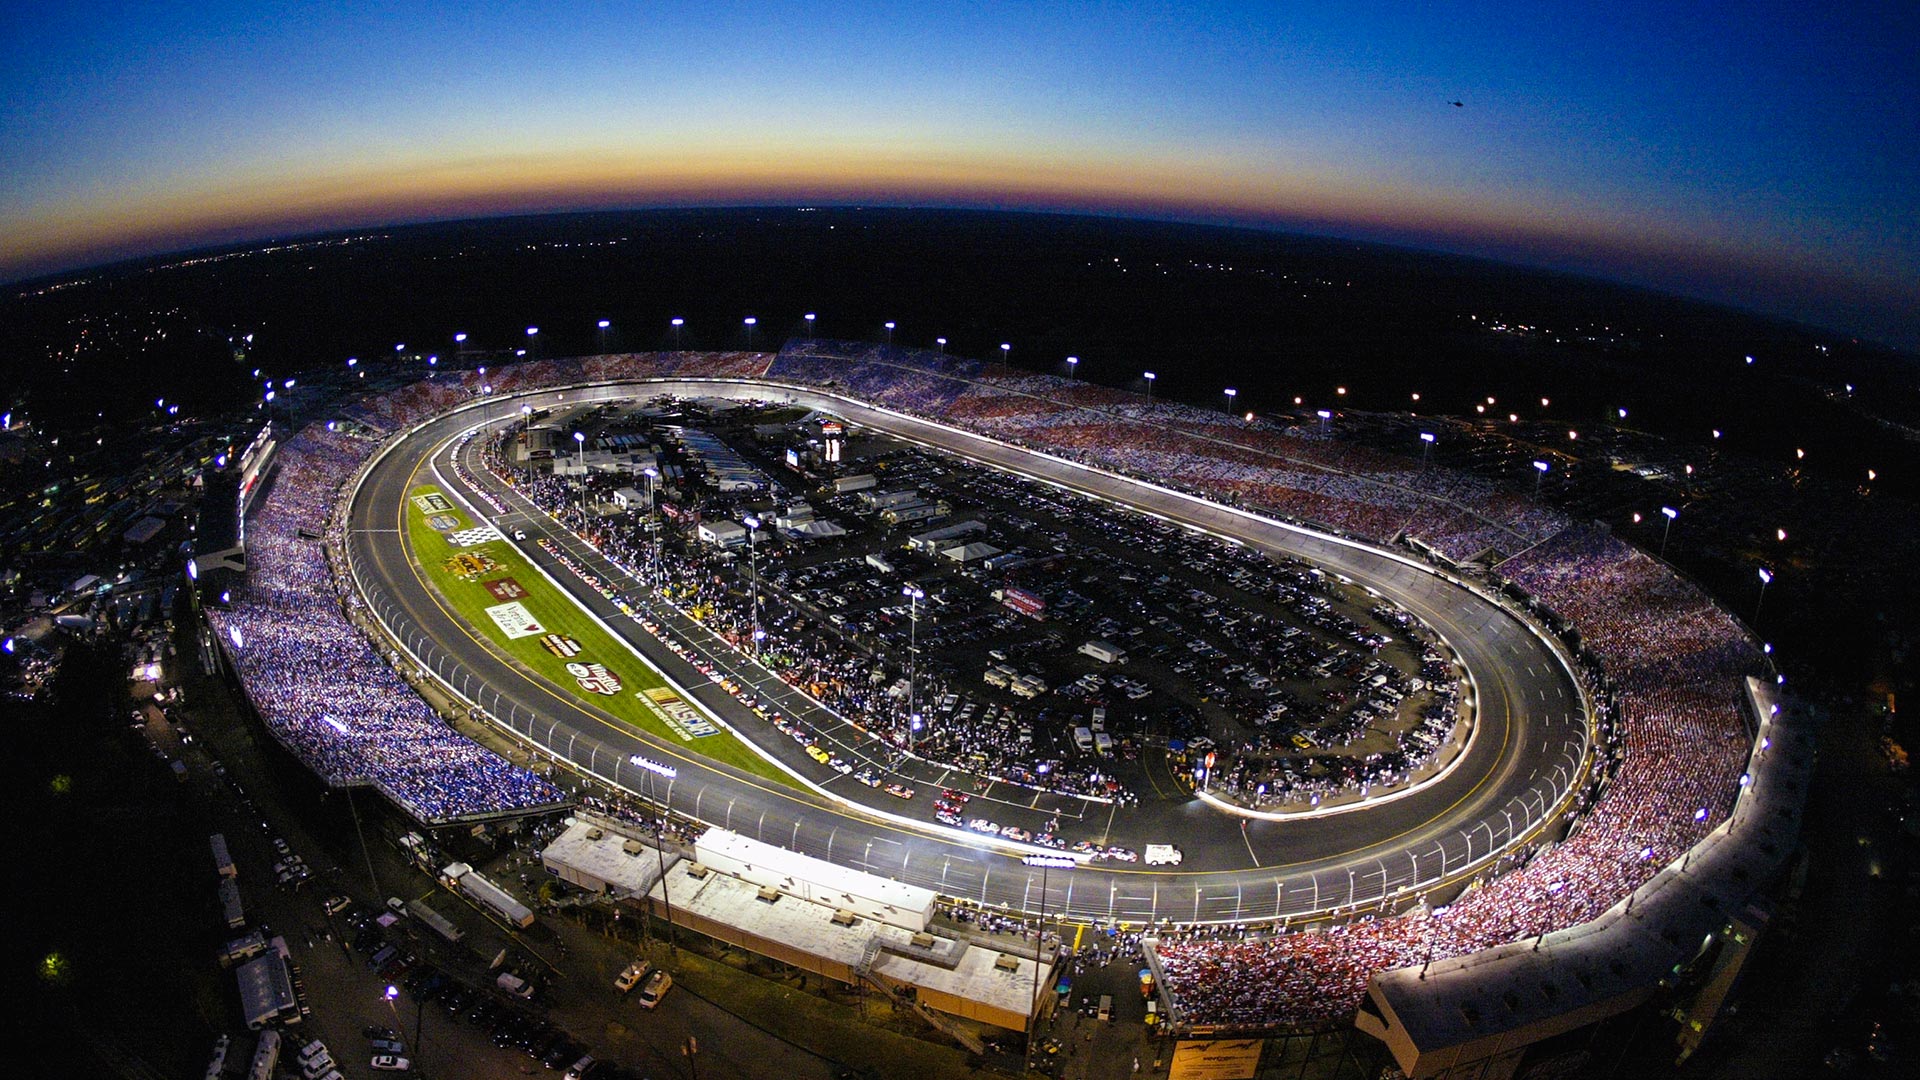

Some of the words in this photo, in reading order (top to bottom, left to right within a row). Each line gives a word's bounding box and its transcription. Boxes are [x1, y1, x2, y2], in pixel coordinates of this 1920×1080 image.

[587, 663, 623, 692] Winston
[635, 692, 693, 741] www.nascar.com
[661, 701, 718, 736] NASCAR
